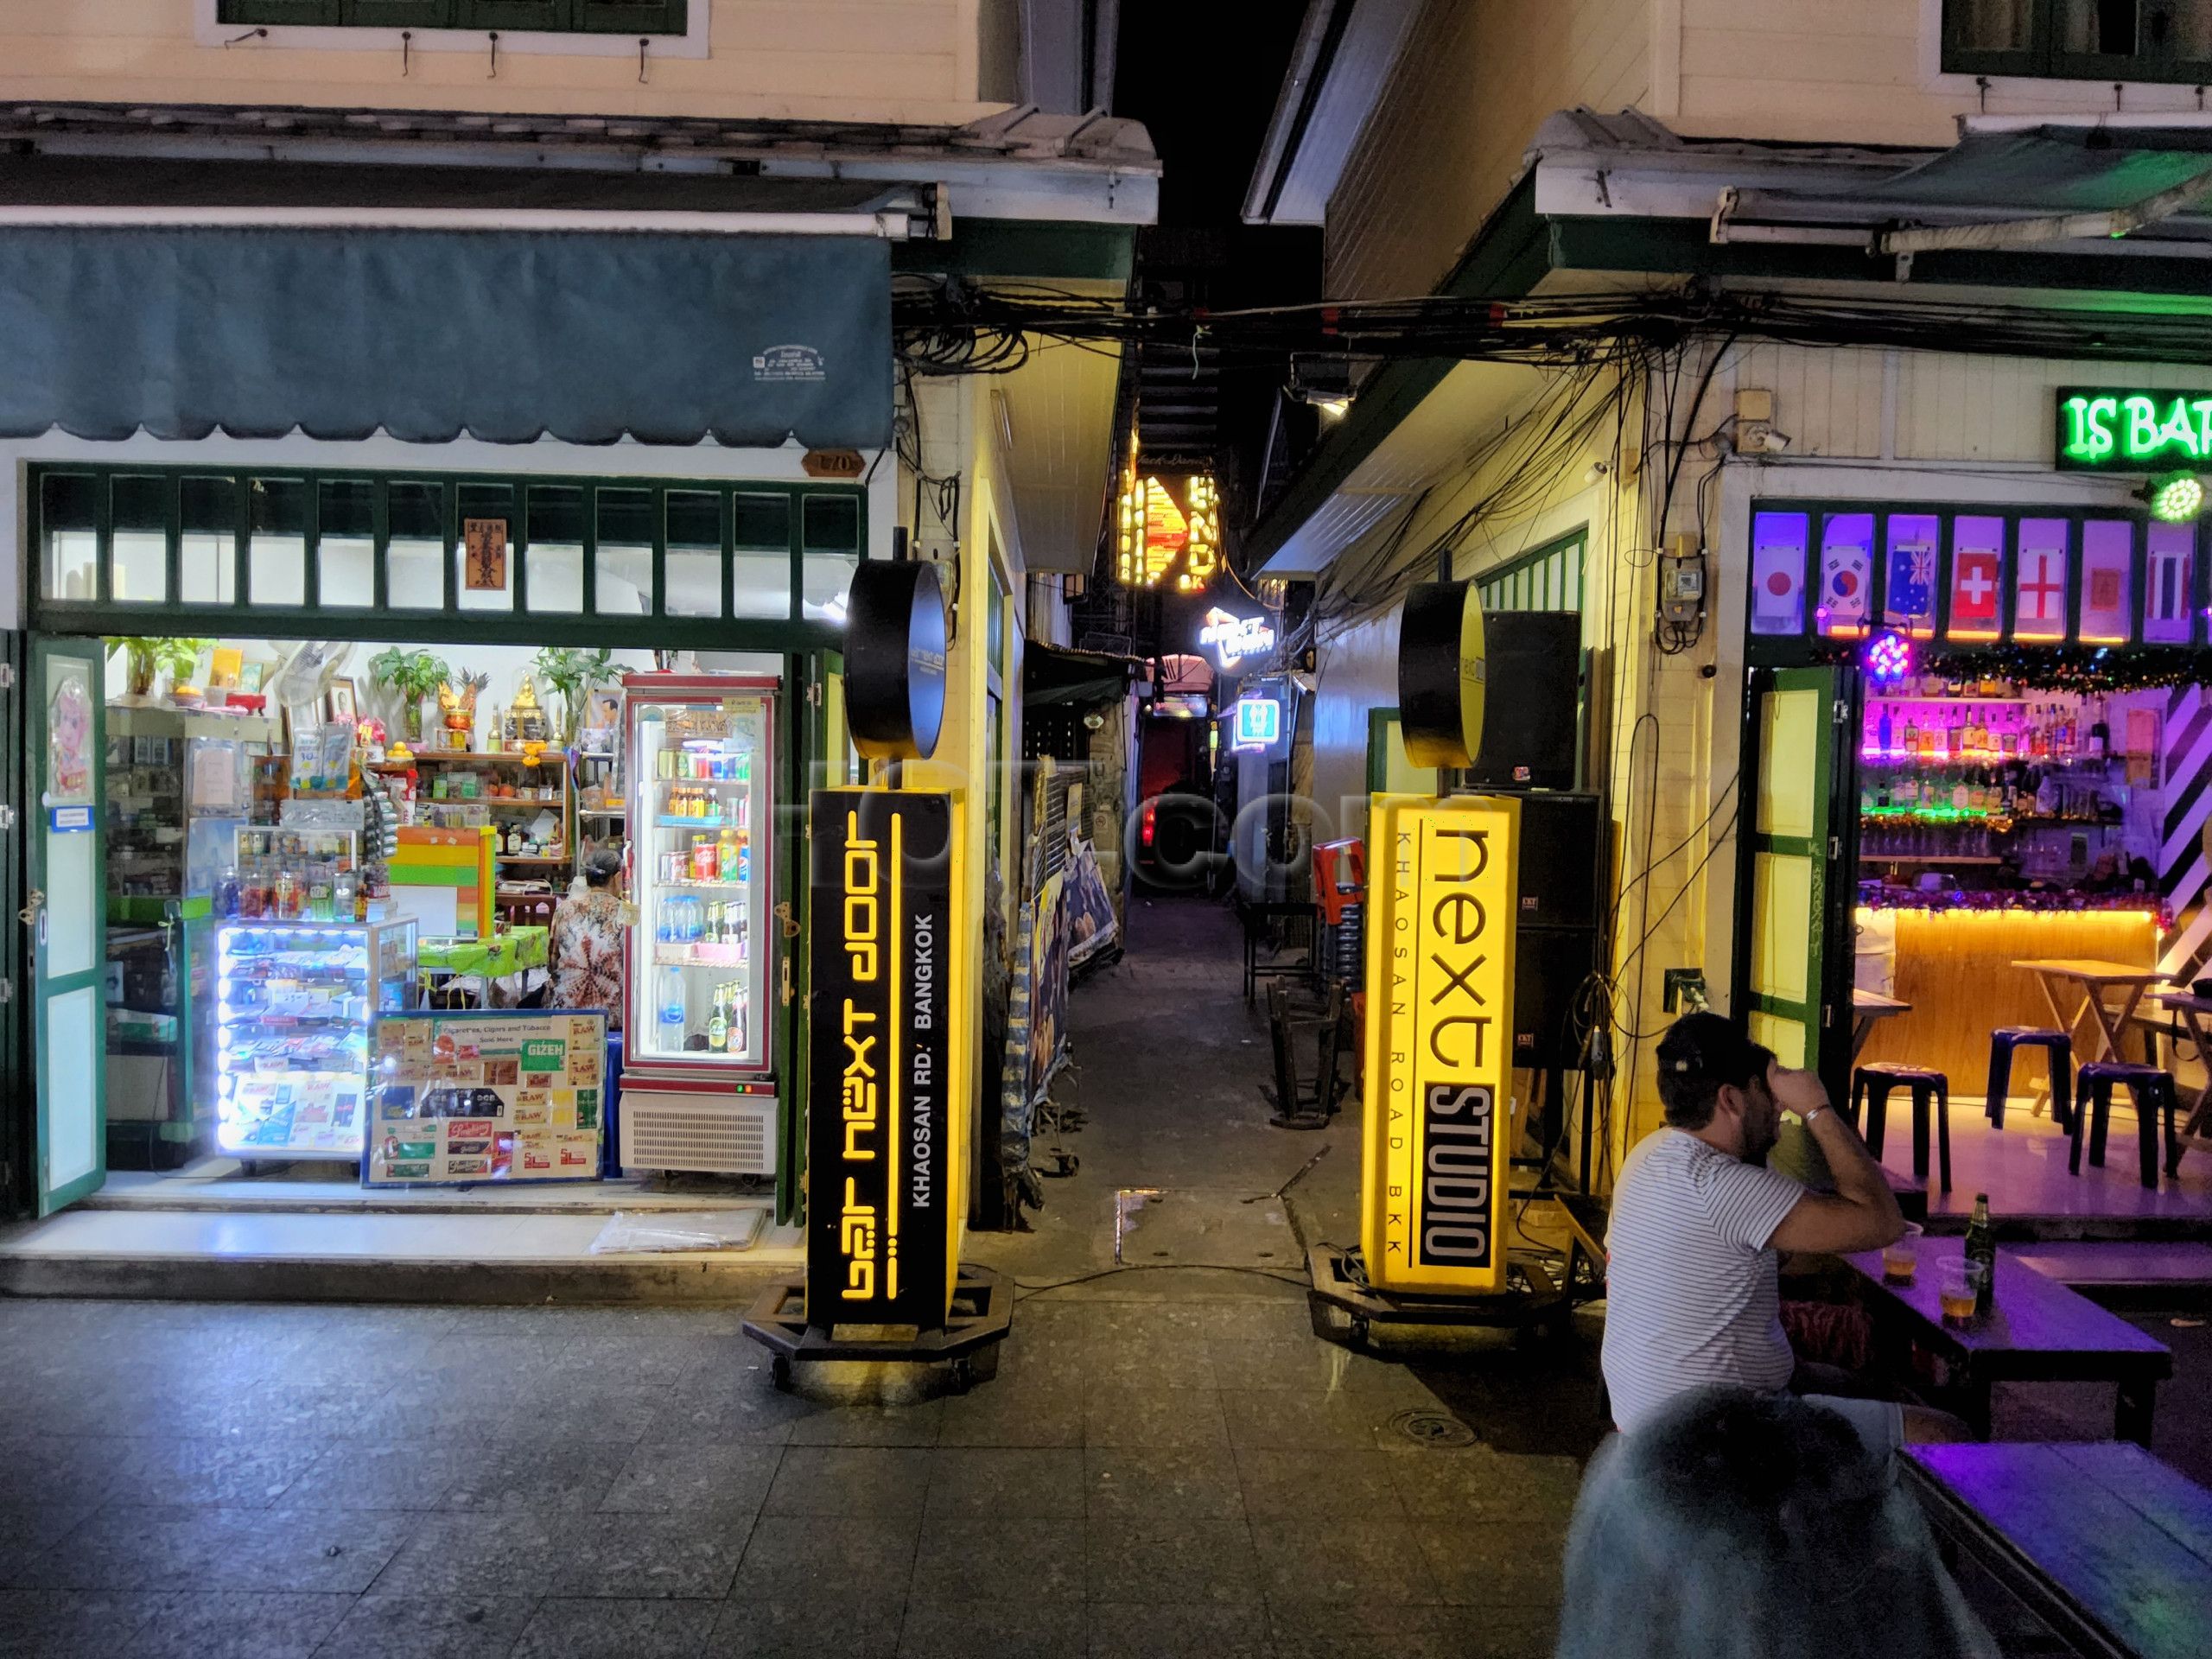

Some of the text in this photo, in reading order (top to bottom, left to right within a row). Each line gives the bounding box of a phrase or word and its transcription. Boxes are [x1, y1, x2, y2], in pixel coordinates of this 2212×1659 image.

[2069, 397, 2116, 459] IS
[914, 914, 933, 1029] BANGKOK
[1430, 830, 1492, 1067] next
[1388, 831, 1411, 1253] KHAOSAN ROAD BKK
[912, 1096, 931, 1207] KHAOSAN
[1426, 1085, 1491, 1257] STUDIO
